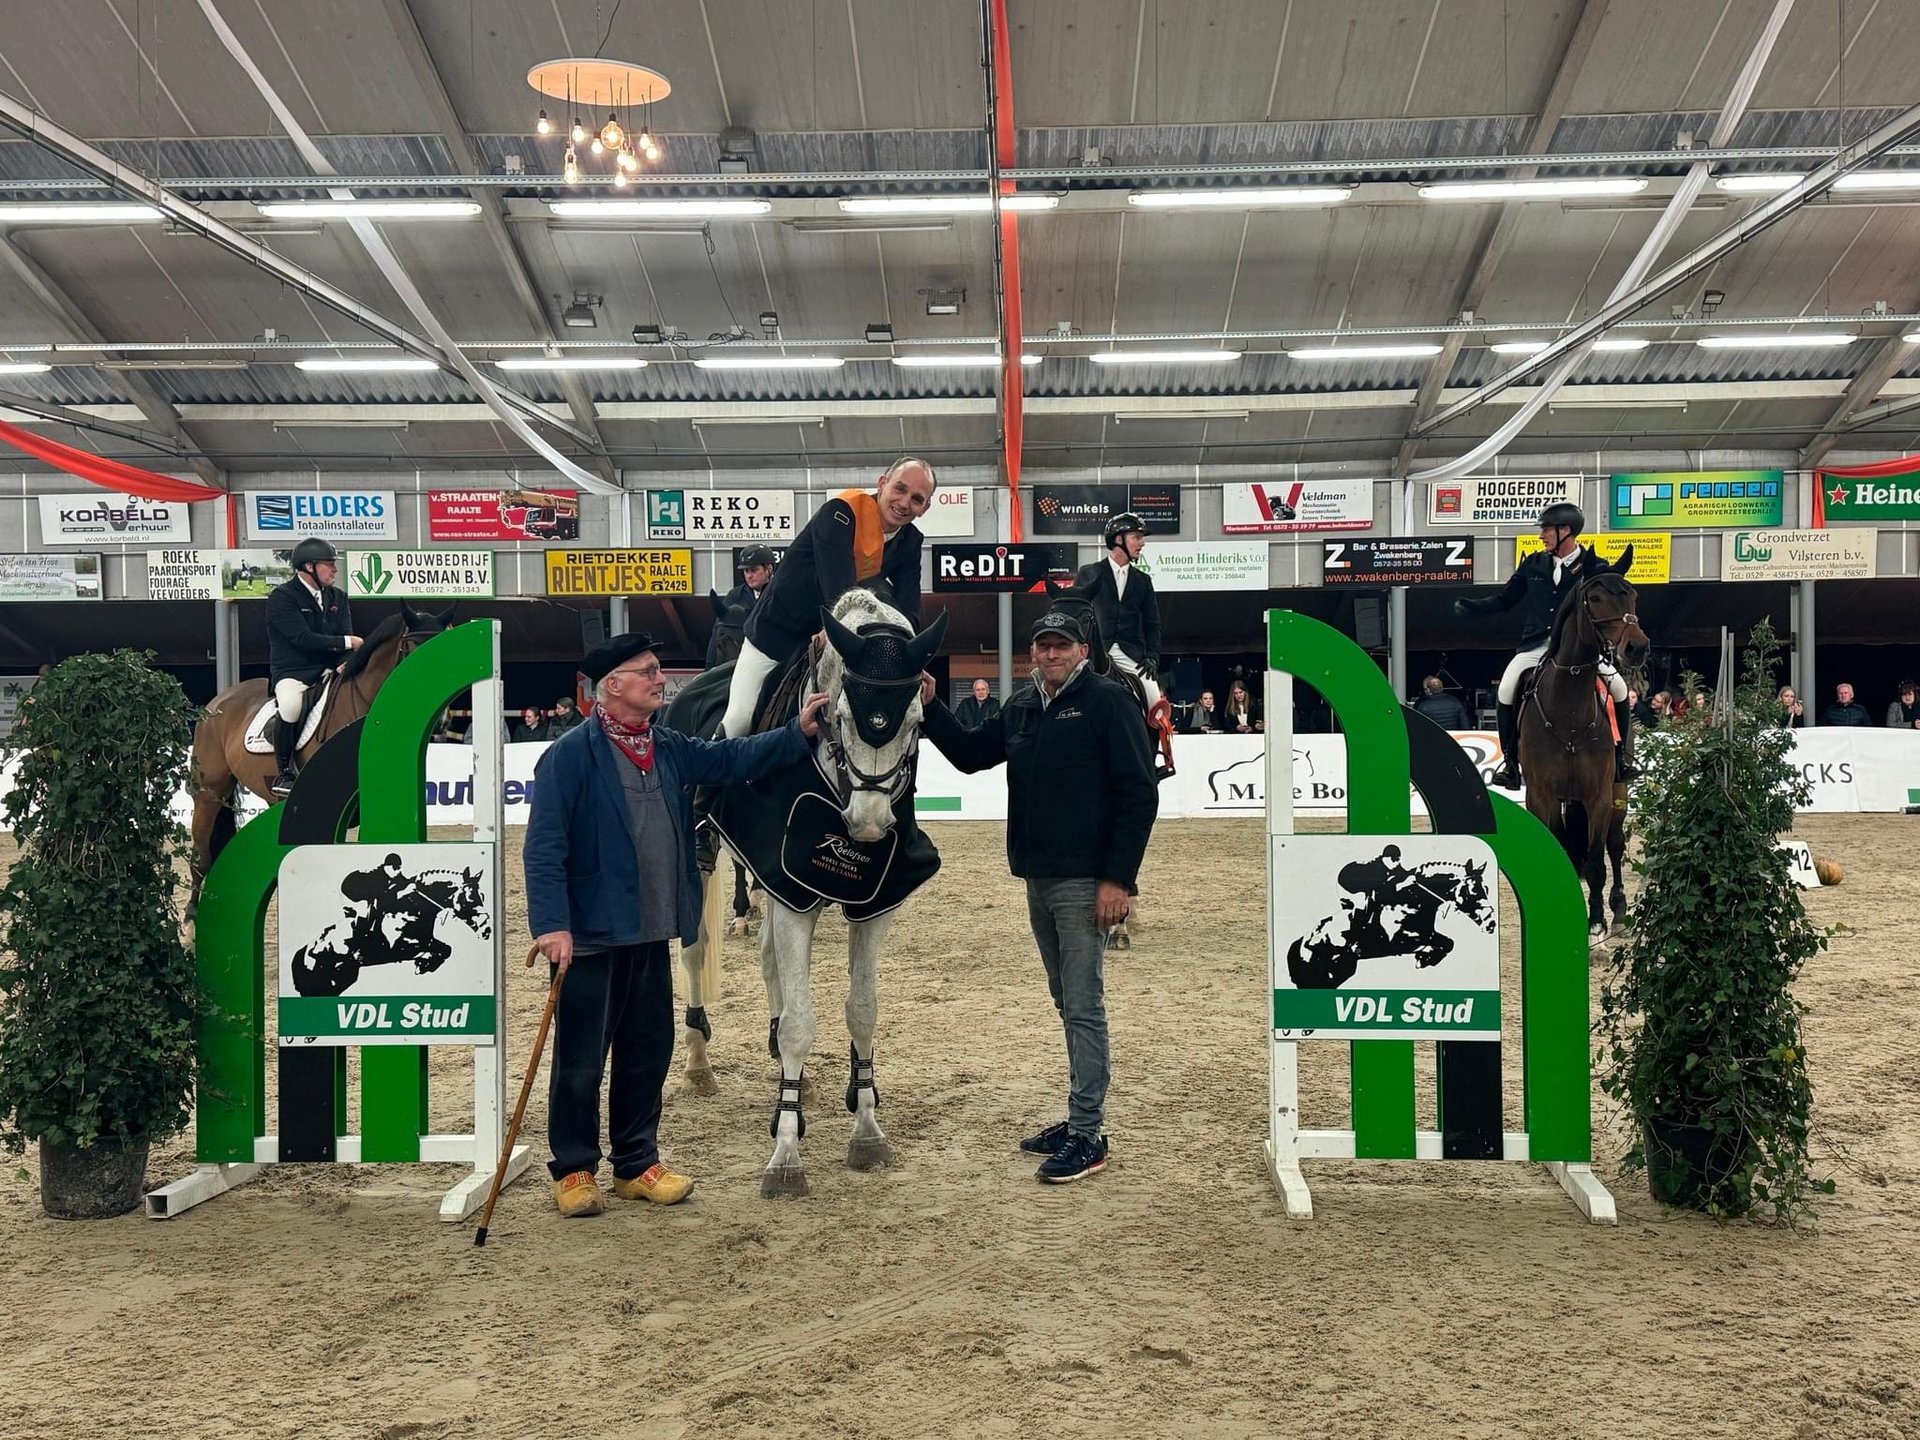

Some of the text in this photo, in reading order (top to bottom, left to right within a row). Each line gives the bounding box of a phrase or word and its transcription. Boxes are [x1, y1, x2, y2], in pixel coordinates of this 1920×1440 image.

[1477, 481, 1566, 496] HOOGEBOOM
[1680, 481, 1778, 498] rensen
[939, 493, 968, 504] OLIE
[1302, 491, 1346, 501] Veldman
[295, 496, 384, 517] ELDERS
[692, 497, 759, 510] REKO
[1061, 504, 1110, 514] winkels
[60, 508, 169, 522] KORBELD
[298, 520, 385, 530] Totaalinstallateur
[692, 516, 790, 529] RAALTE
[84, 534, 150, 542] www.korbeld.nl
[1756, 532, 1830, 544] Grondverzet
[1421, 541, 1443, 549] Zalen
[163, 551, 199, 563] ROEKE
[397, 554, 489, 566] BOUWBEDRIJF
[566, 553, 671, 564] RIETDEKKER
[1156, 554, 1193, 565] Antoon
[1197, 553, 1248, 565] Hinderiks
[1373, 551, 1422, 559] Zwakenberg
[1789, 550, 1864, 561] Vilsteren b.v.
[150, 565, 216, 576] PAARDENSPORT
[650, 565, 687, 576] RAALTE
[1325, 570, 1473, 583] www.zwakenberg-raalte.nl
[150, 578, 190, 588] FOURAGE
[400, 570, 490, 584] VOSMAN B.V.
[552, 566, 646, 592] RIENTJES
[664, 580, 687, 591] 2429
[150, 589, 210, 600] VEEVOEDERS
[816, 834, 871, 863] Roelofsen
[337, 1003, 469, 1028] VDL Stud
[1335, 997, 1474, 1023] VDL Stud
